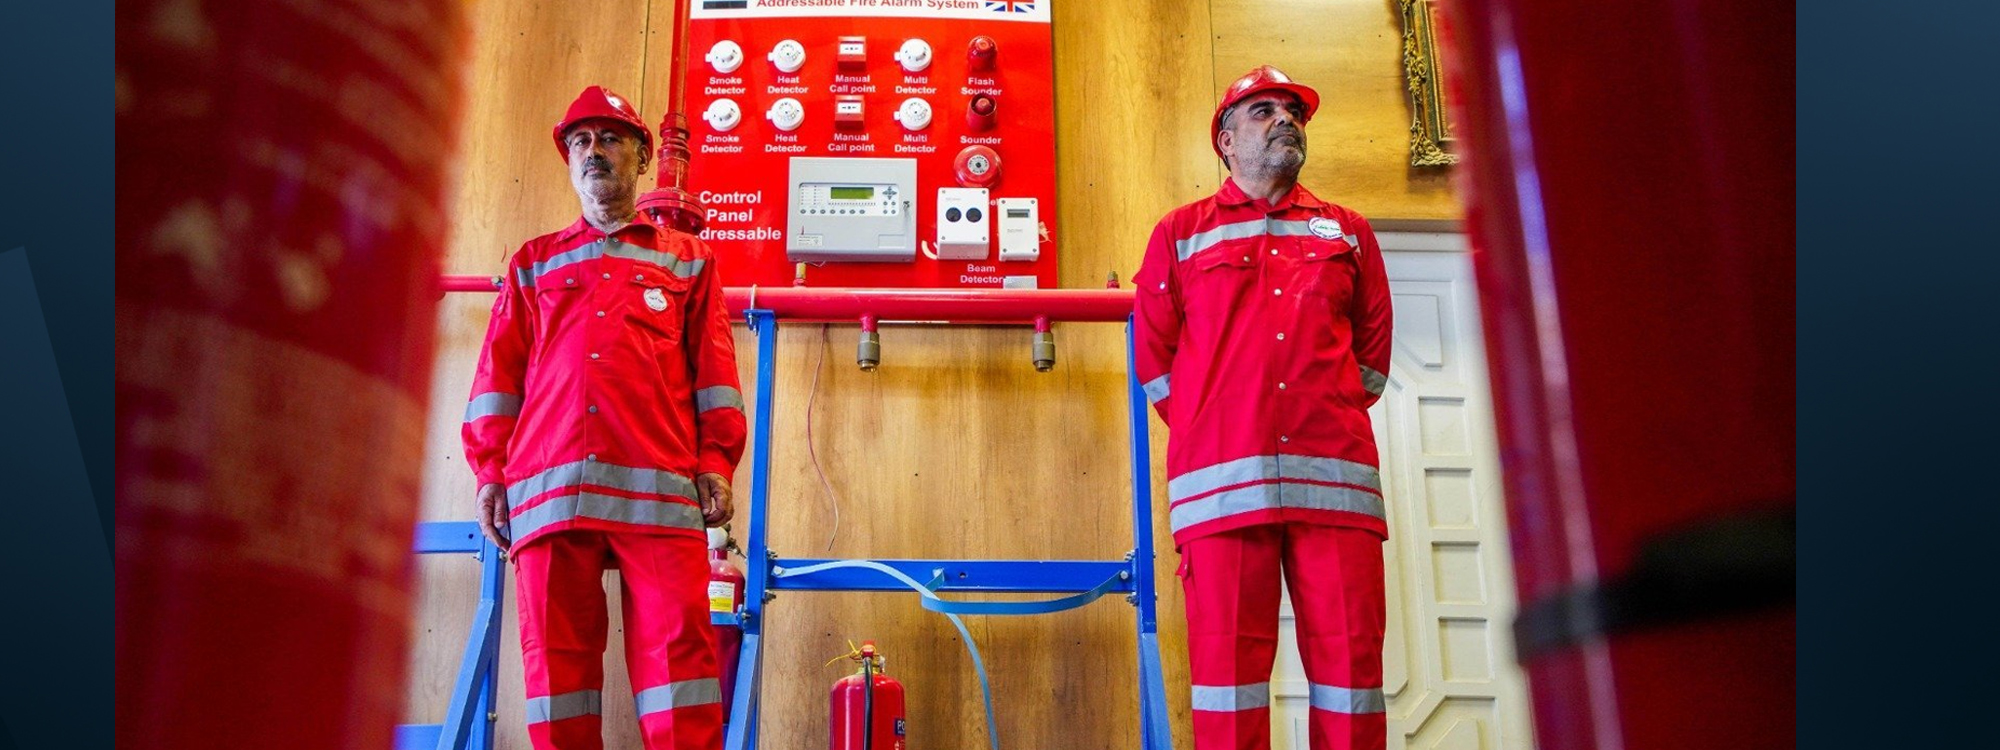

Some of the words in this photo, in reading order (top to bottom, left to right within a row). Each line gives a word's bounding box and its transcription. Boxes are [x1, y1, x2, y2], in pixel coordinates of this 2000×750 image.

[927, 0, 979, 10] System
[709, 76, 742, 85] Smoke
[777, 75, 799, 84] Heat
[835, 74, 870, 83] Manual
[904, 75, 928, 84] Multi
[968, 77, 995, 86] Flash
[704, 86, 746, 95] Detector
[767, 85, 809, 94] Detector
[829, 85, 849, 93] Call
[850, 85, 876, 94] point
[895, 85, 937, 94] Detector
[961, 86, 1002, 96] Sounder
[706, 134, 740, 143] Smoke
[775, 134, 798, 142] Heat
[834, 133, 869, 141] Manual
[903, 134, 928, 142] Multi
[960, 135, 1002, 144] Sounder
[701, 144, 743, 153] Detector
[765, 144, 807, 153] Detector
[827, 143, 847, 151] Call
[849, 143, 875, 153] point
[894, 144, 937, 153] Detector
[700, 190, 761, 204] Control
[706, 208, 753, 222] Panel
[699, 226, 782, 240] dressable
[967, 263, 996, 273] Beam
[960, 274, 1004, 284] Detector
